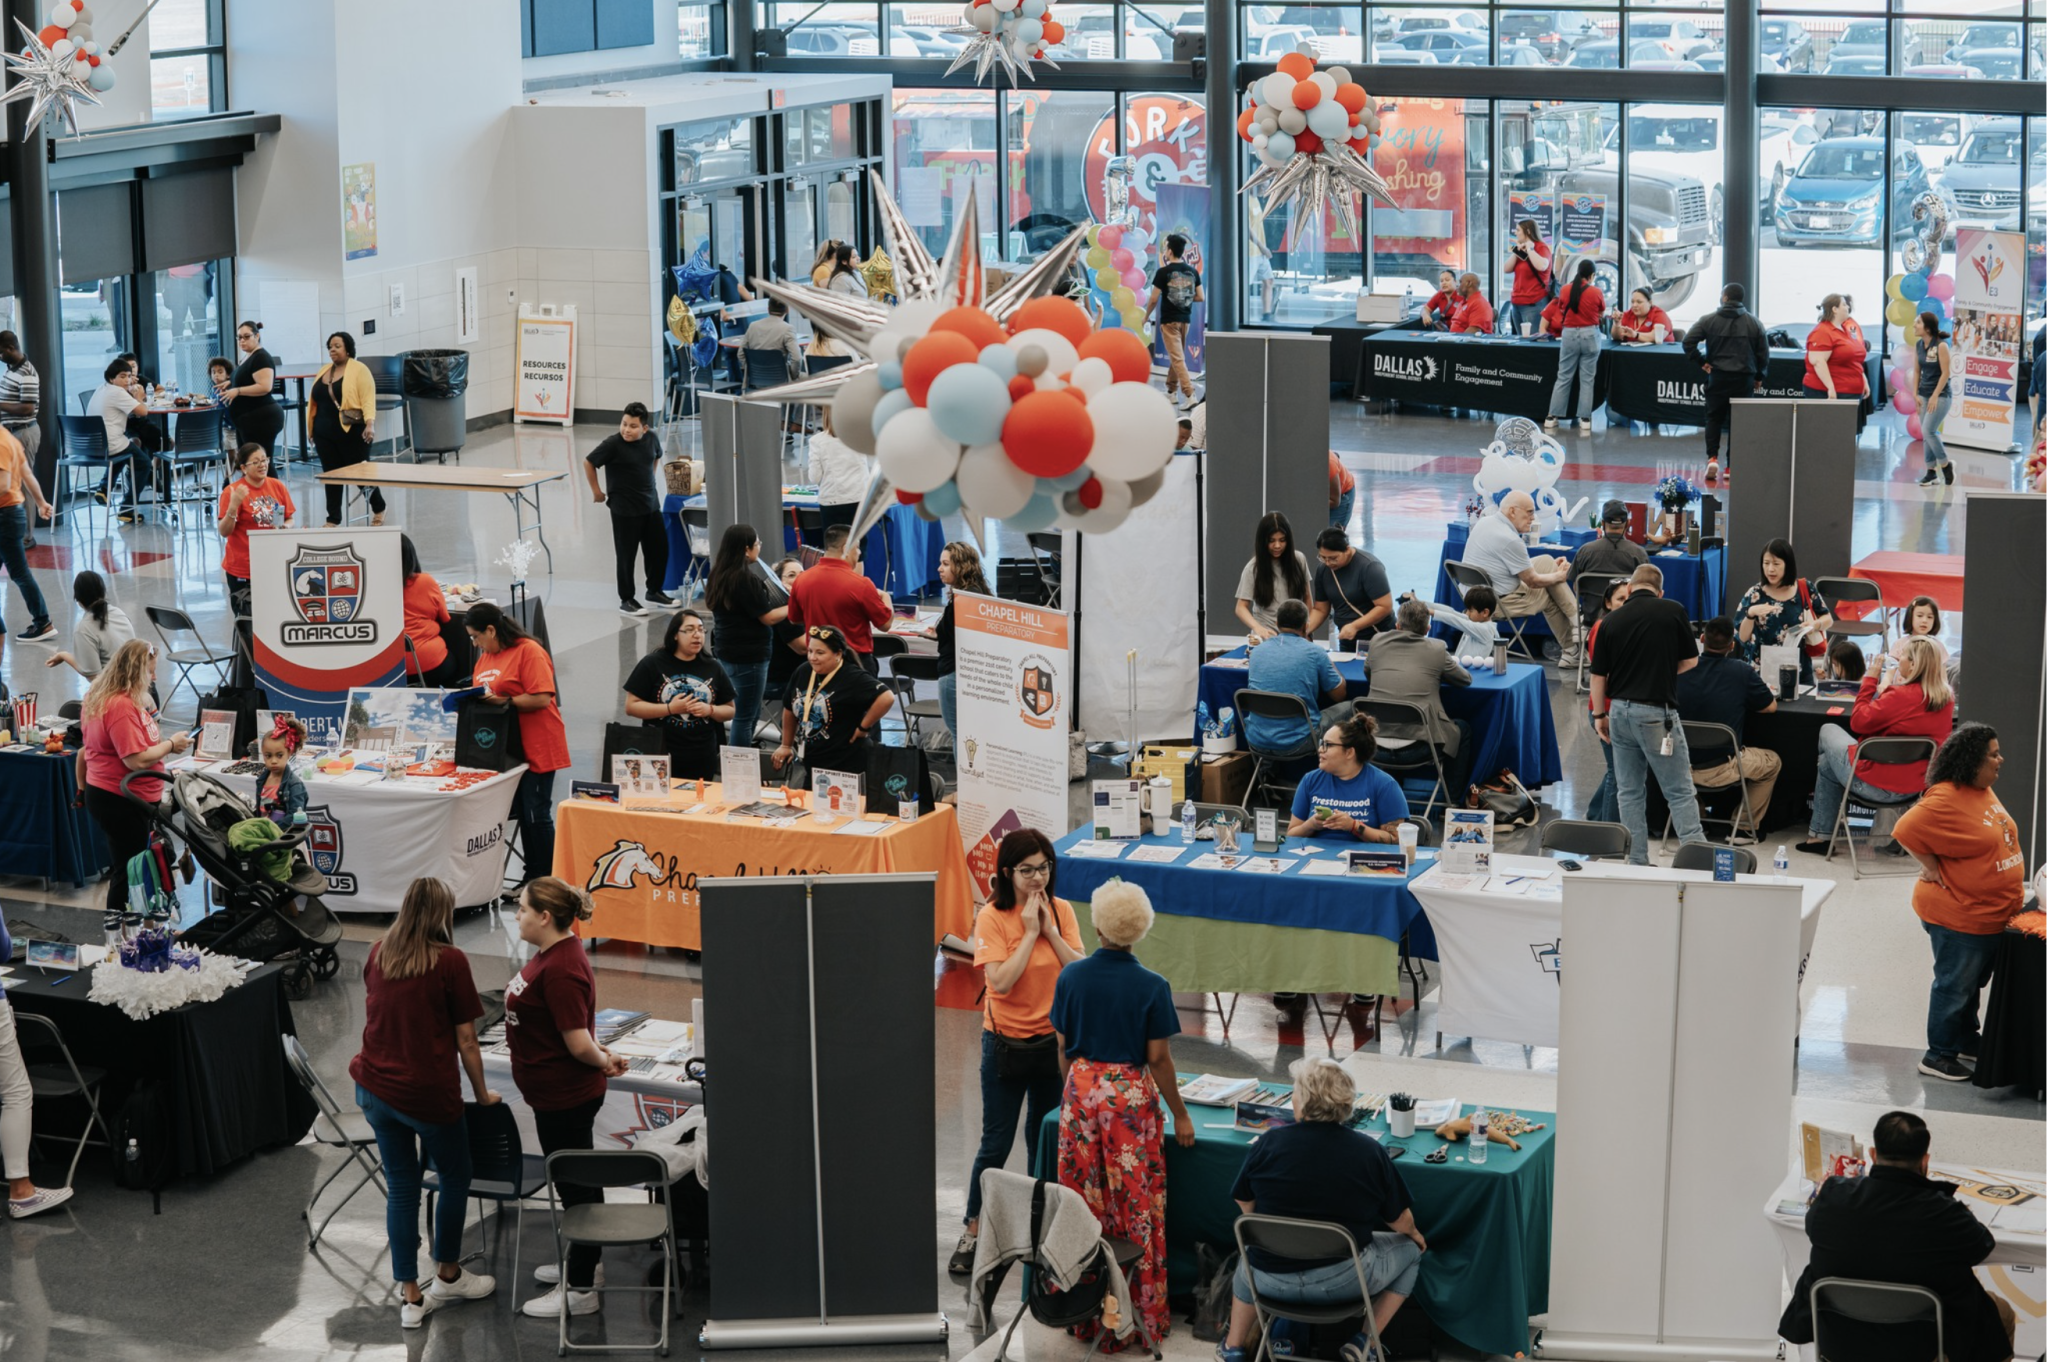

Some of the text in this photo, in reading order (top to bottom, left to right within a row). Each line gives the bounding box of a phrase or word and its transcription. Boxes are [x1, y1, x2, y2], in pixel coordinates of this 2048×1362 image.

[1374, 125, 1445, 168] vory
[1386, 158, 1446, 201] shing
[1989, 287, 1998, 297] E3
[523, 360, 566, 370] RESOURCES
[1374, 354, 1423, 377] DALLAS
[1455, 363, 1543, 383] Family and Community
[1967, 360, 1999, 376] Engage
[524, 372, 563, 382] RECURSOS
[1454, 374, 1503, 386] Engagement
[1657, 380, 1706, 401] DALLAS
[1965, 382, 2000, 397] Educate
[1964, 403, 2003, 419] Empower
[302, 555, 327, 563] COLLEGE
[978, 603, 1044, 627] CHAPEL HILL
[288, 625, 370, 641] MARCUS
[986, 622, 1036, 639] PREPARATORY
[960, 647, 976, 656] Chapel
[985, 652, 1012, 664] Preparatory
[959, 664, 974, 672] school
[967, 658, 985, 666] premier
[995, 664, 1013, 674] century
[976, 684, 1005, 696] personalized
[987, 678, 1002, 686] whole
[1002, 681, 1013, 689] child
[962, 689, 980, 700] learning
[1311, 795, 1370, 807] Prestonwood
[467, 828, 497, 854] DALLAS
